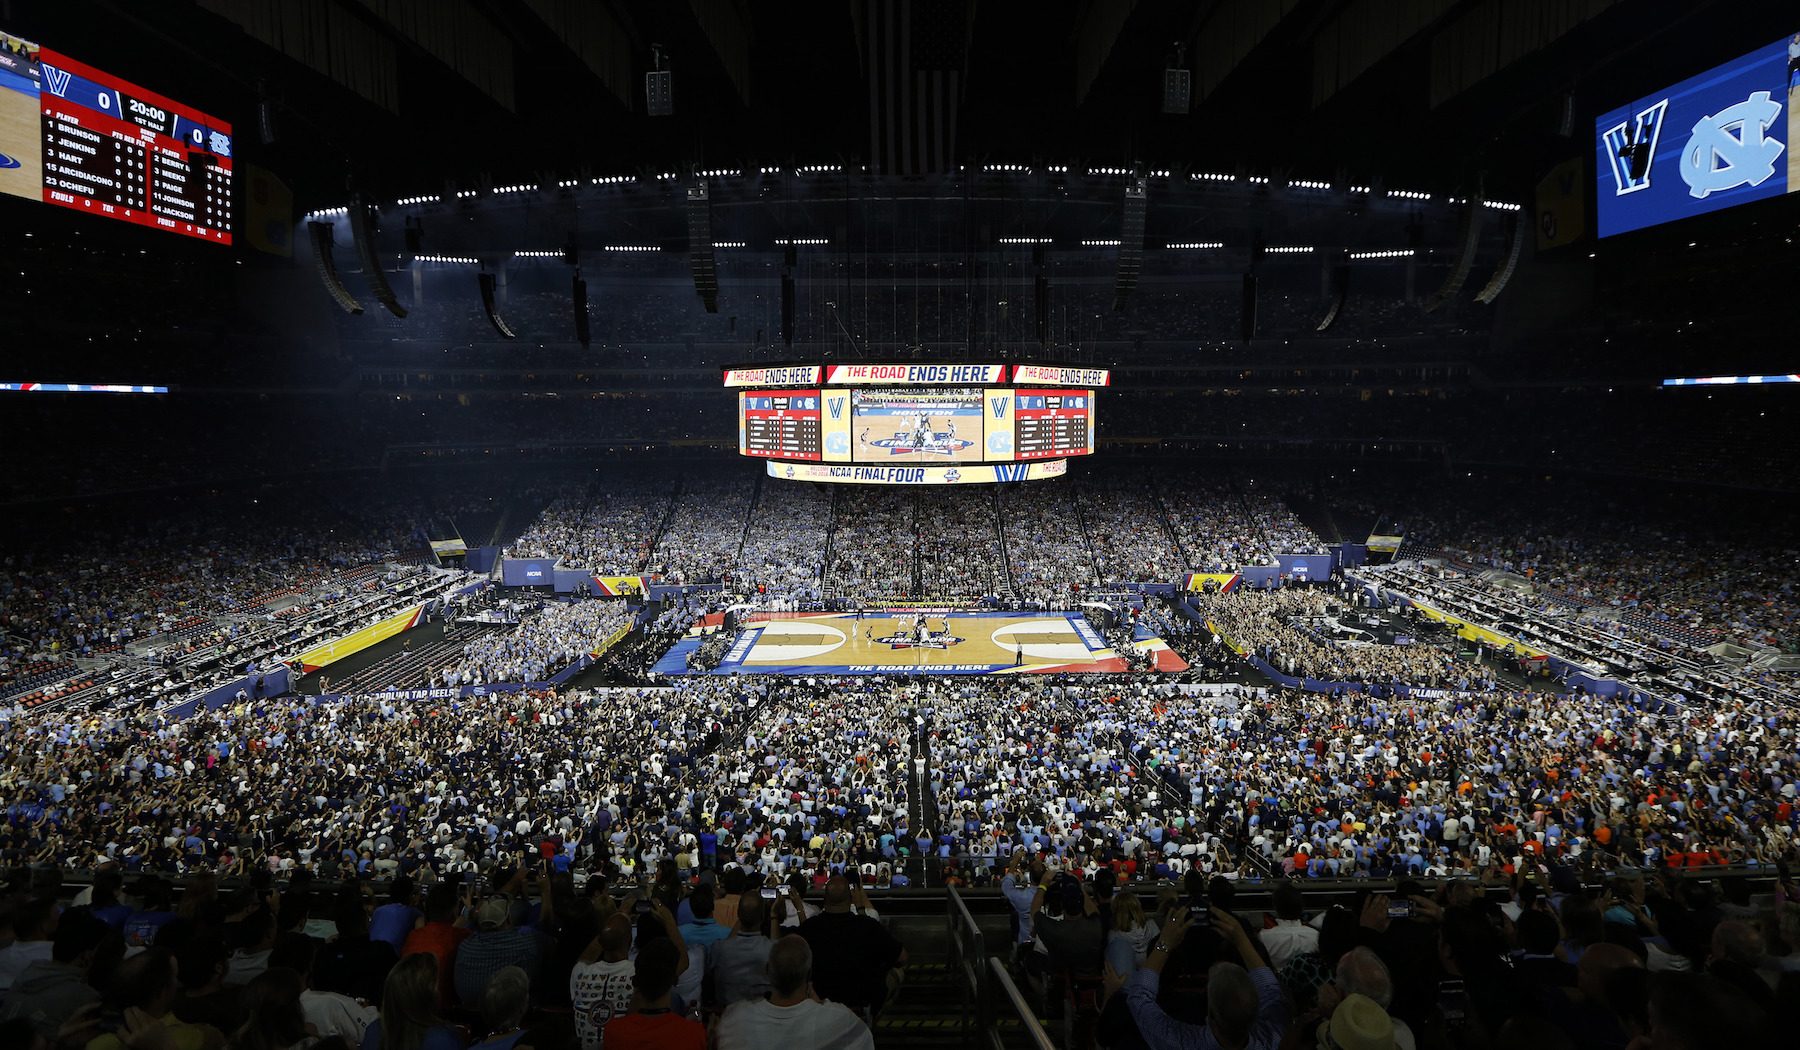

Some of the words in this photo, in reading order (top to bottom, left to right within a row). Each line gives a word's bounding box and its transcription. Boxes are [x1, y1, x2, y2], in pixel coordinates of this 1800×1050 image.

[42, 64, 72, 98] V
[98, 92, 110, 109] 0
[130, 99, 165, 122] 20:00
[56, 112, 79, 125] PLAYER
[112, 131, 123, 140] PTS
[124, 134, 134, 144] REB
[136, 139, 146, 148] FLS
[134, 116, 147, 126] 1ST
[148, 121, 164, 132] HALF
[58, 123, 100, 143] BRUNSON
[192, 128, 202, 143] 0
[48, 134, 54, 142] 2
[58, 138, 96, 155] JENKINS
[1602, 98, 1668, 196] V
[58, 152, 83, 165] HART
[162, 148, 180, 159] PLAYER
[162, 157, 184, 170] BERRY
[46, 163, 57, 171] 15
[59, 166, 113, 186] ARCIDIACONO
[162, 170, 186, 182] MEEKS
[46, 176, 57, 186] 23
[59, 180, 94, 195] OCHEFU
[162, 182, 183, 194] PAIGE
[51, 191, 74, 203] FOULS
[102, 204, 114, 213] TOL
[162, 195, 195, 209] JOHNSON
[162, 207, 194, 221] JACKSON
[158, 217, 176, 228] FOULS
[733, 371, 744, 381] THE
[745, 370, 764, 382] ROAD
[765, 368, 787, 384] ENDS
[788, 367, 812, 383] HERE
[848, 366, 868, 377] THE
[870, 366, 906, 378] ROAD
[908, 366, 947, 381] ENDS
[950, 366, 990, 381] HERE
[1024, 368, 1037, 378] THE
[1038, 368, 1058, 380] ROAD
[1060, 369, 1081, 383] ENDS
[1082, 370, 1102, 384] HERE
[827, 396, 846, 420] V
[990, 396, 1010, 420] V
[830, 467, 851, 477] NCAA
[854, 468, 885, 480] FINAL
[887, 468, 925, 482] FOUR
